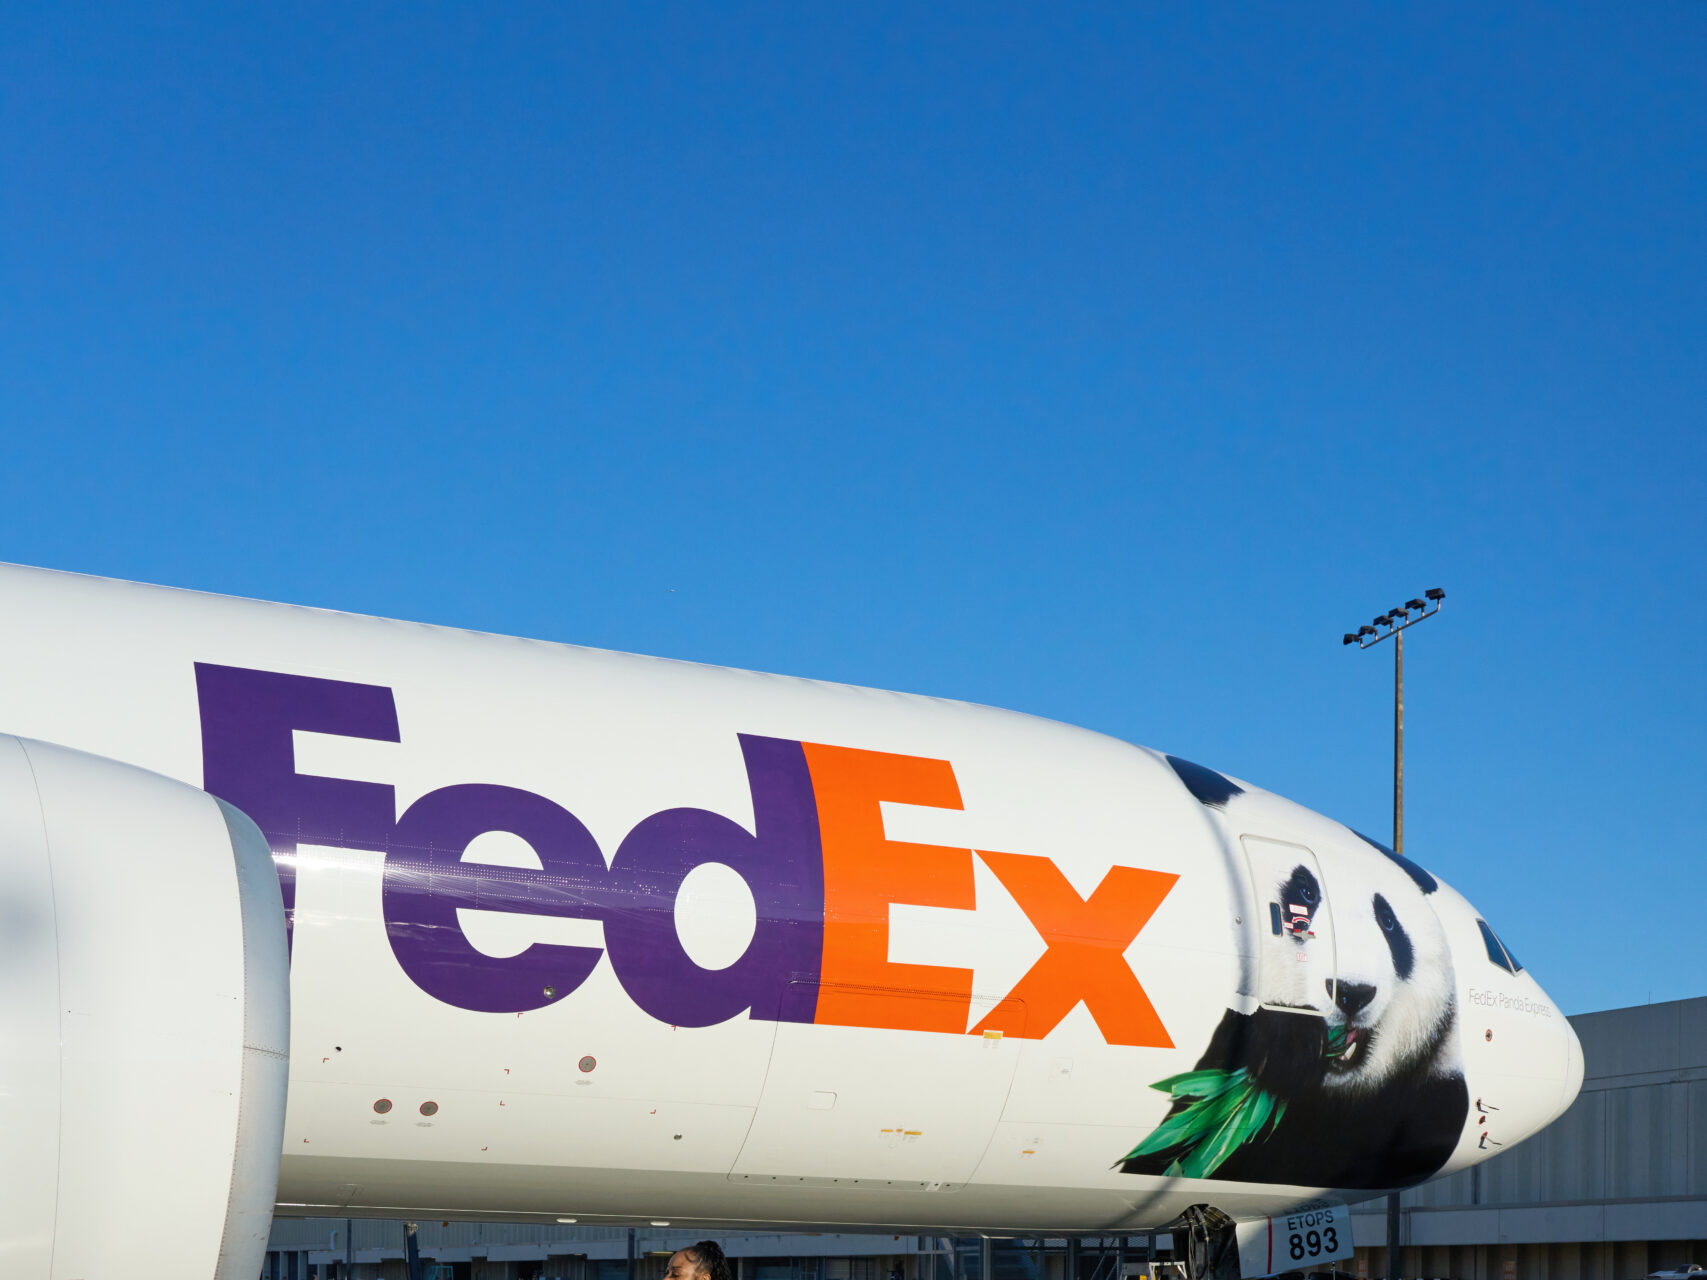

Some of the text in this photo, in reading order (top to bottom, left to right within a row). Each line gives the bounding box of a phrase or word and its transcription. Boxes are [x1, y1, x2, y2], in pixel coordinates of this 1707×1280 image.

[194, 661, 1180, 1047] FedEx
[1468, 988, 1551, 1018] FedEx Panda Express
[1286, 1209, 1334, 1231] ETOPS
[1288, 1226, 1339, 1260] 893
